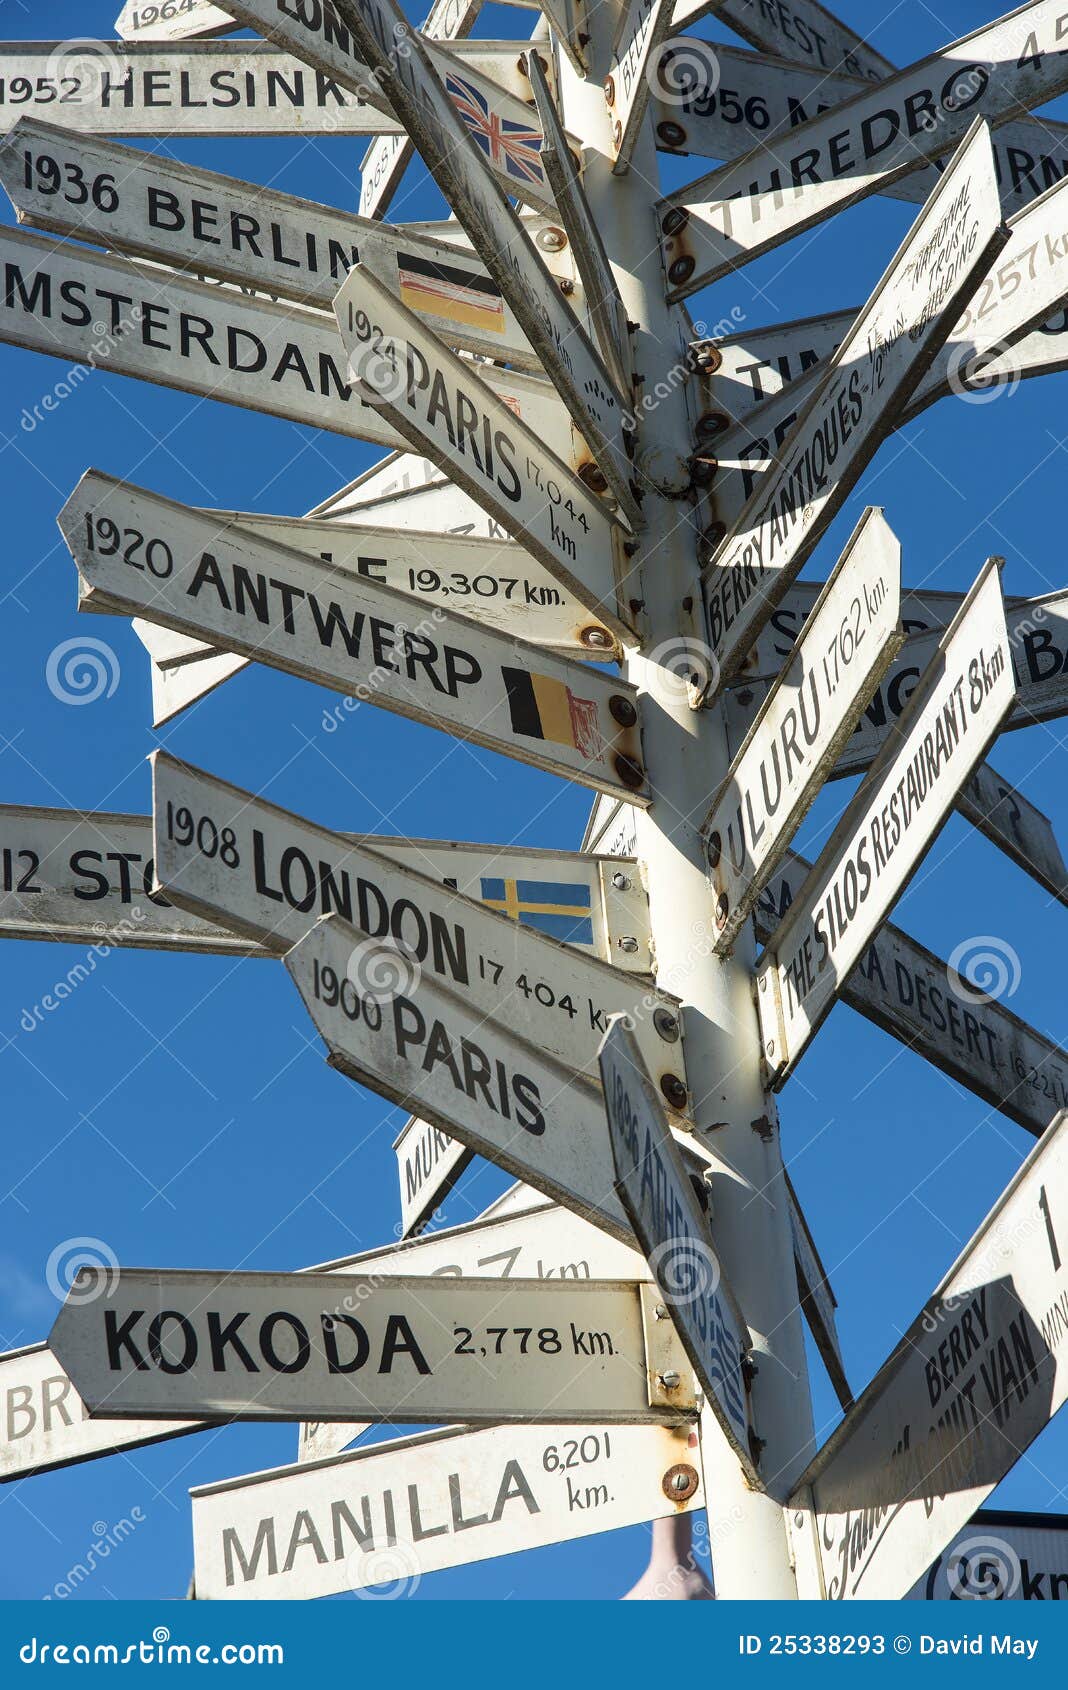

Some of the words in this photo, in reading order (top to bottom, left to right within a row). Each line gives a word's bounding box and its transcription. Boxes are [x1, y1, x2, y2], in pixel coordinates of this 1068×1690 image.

[100, 70, 367, 108] HELSINK
[709, 63, 989, 240] THREDBO
[23, 151, 120, 213] 1936
[147, 186, 361, 280] BERLIN
[928, 203, 972, 291] TRUST
[406, 340, 522, 503] PARIS
[408, 568, 519, 600] 19,307
[549, 505, 577, 561] km
[709, 540, 766, 650] BERRY
[768, 369, 864, 562] ANTIQUES
[84, 511, 174, 579] 1920
[186, 552, 482, 698] ANTWERP
[727, 668, 822, 878] ULURU
[782, 934, 817, 1022] THE
[813, 836, 872, 973] SILOS
[869, 673, 969, 879] RESTAURANT
[166, 800, 241, 870] 1908
[252, 828, 470, 986] LONDON
[312, 958, 383, 1032] 1900
[391, 990, 546, 1137] PARIS
[103, 1309, 434, 1375] KOKODA
[452, 1327, 562, 1357] 2,778
[924, 1287, 990, 1409] BERRY
[979, 1309, 1040, 1426] VAN
[221, 1458, 542, 1587] MANILLA
[542, 1431, 612, 1475] 6,201
